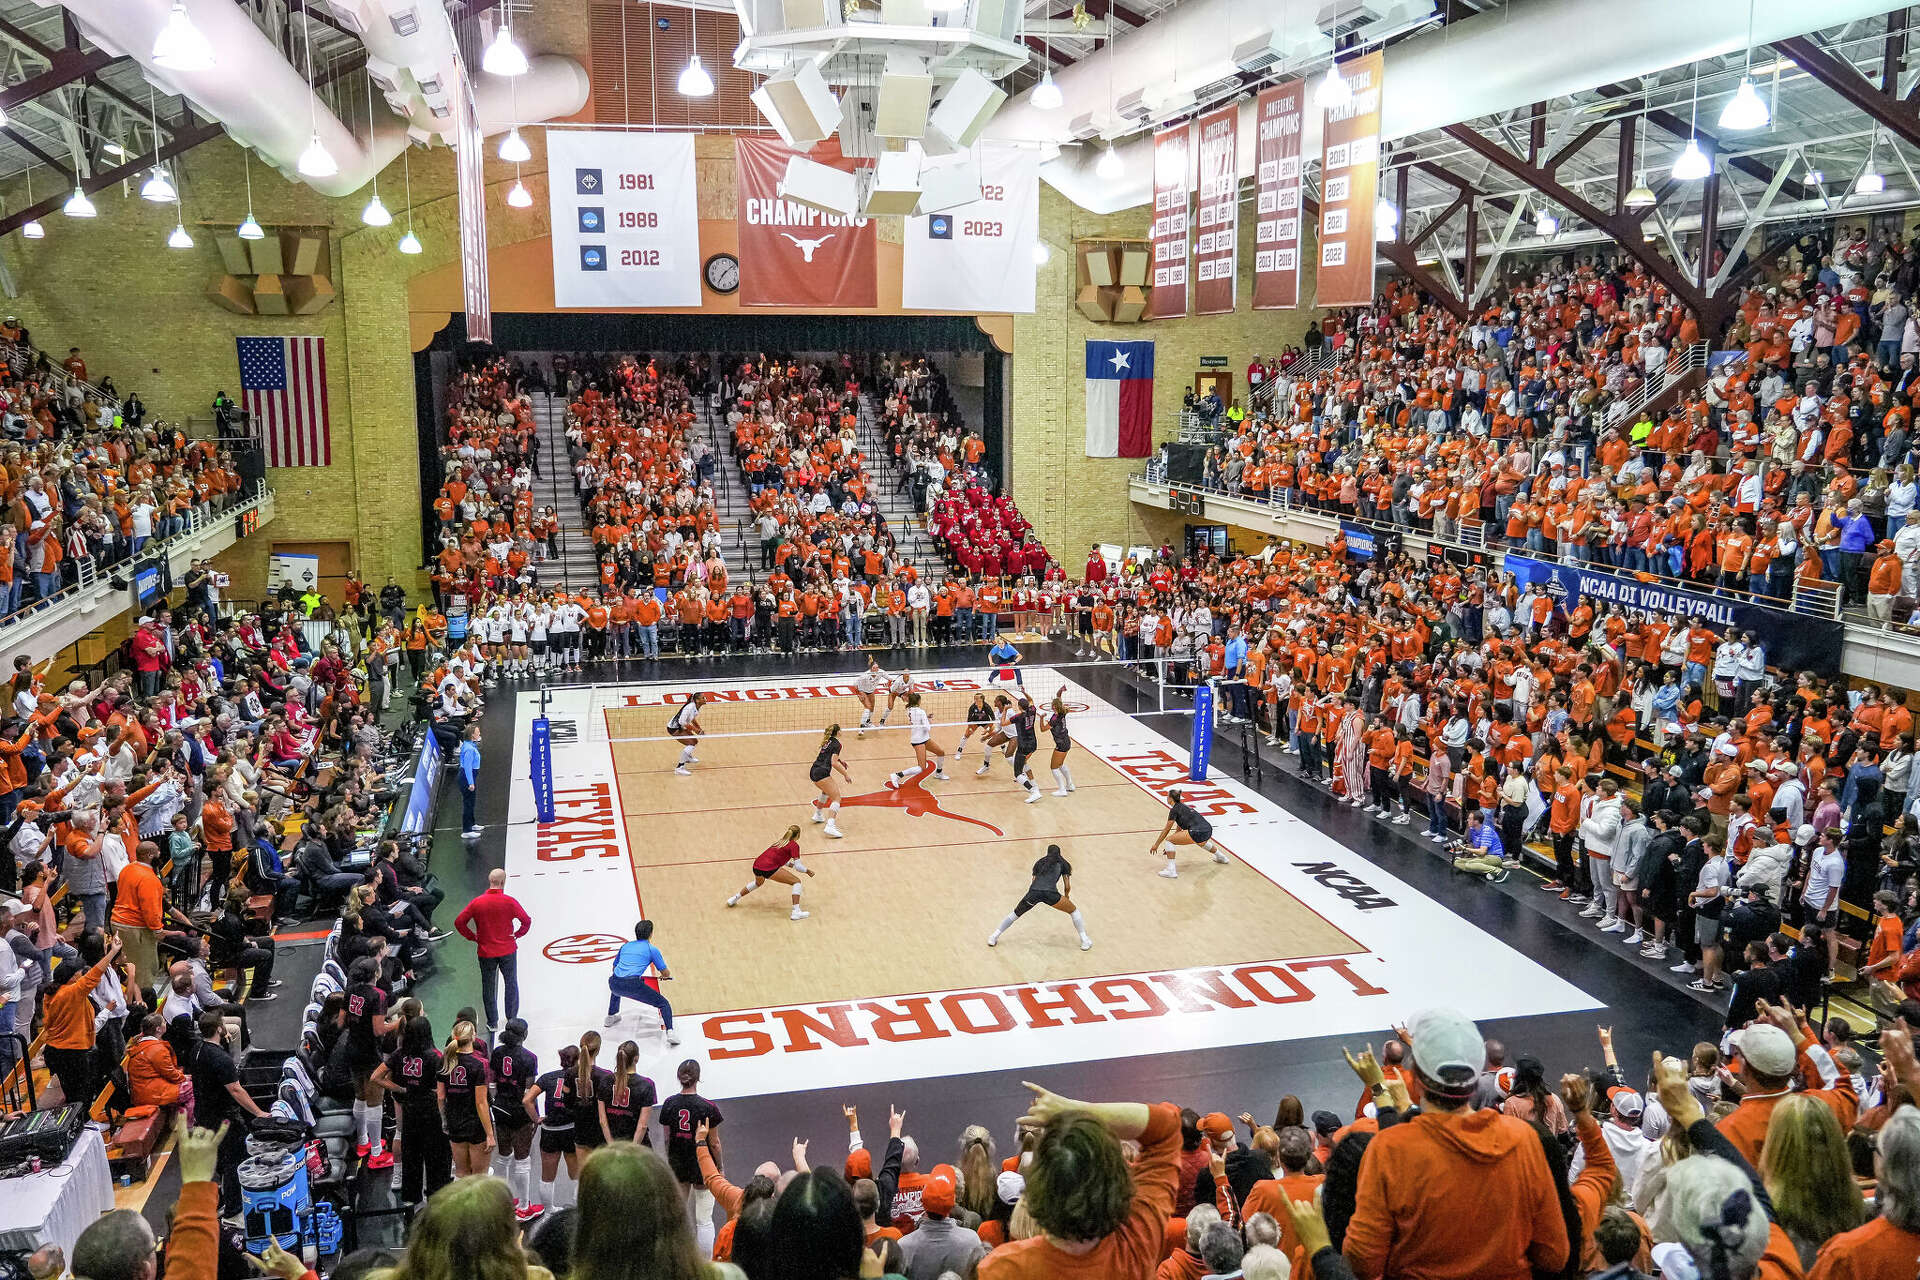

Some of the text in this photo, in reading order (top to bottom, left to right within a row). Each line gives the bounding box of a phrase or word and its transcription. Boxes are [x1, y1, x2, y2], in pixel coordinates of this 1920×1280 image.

[1261, 112, 1299, 141] CHAMPIONS
[1329, 150, 1345, 165] 2019
[1282, 162, 1295, 174] 2014
[618, 174, 655, 190] 1981
[981, 186, 1004, 200] 22
[618, 212, 658, 228] 1988
[964, 221, 1003, 237] 2023
[1280, 224, 1293, 237] 2017
[621, 250, 660, 266] 2012
[1278, 253, 1292, 268] 2018
[1325, 246, 1342, 262] 2022
[1345, 535, 1373, 552] HAMPIONS
[1579, 576, 1616, 600] NCAA
[1618, 585, 1637, 604] DI
[1640, 589, 1736, 626] VOLLEYBALL
[622, 678, 982, 707] LONGHONS
[1198, 703, 1206, 772] VOLLEYBALL
[539, 738, 548, 813] VOLLEYBALL
[1107, 750, 1259, 817] TEXAS
[537, 782, 620, 862] TEXAS
[1290, 861, 1399, 911] NCAA
[349, 993, 365, 1017] 52
[701, 958, 1389, 1061] LONGHORNS
[402, 1056, 423, 1078] 23
[450, 1065, 468, 1086] 12
[502, 1056, 513, 1076] 6
[678, 1109, 690, 1131] 2
[892, 1190, 923, 1203] HAMPIO
